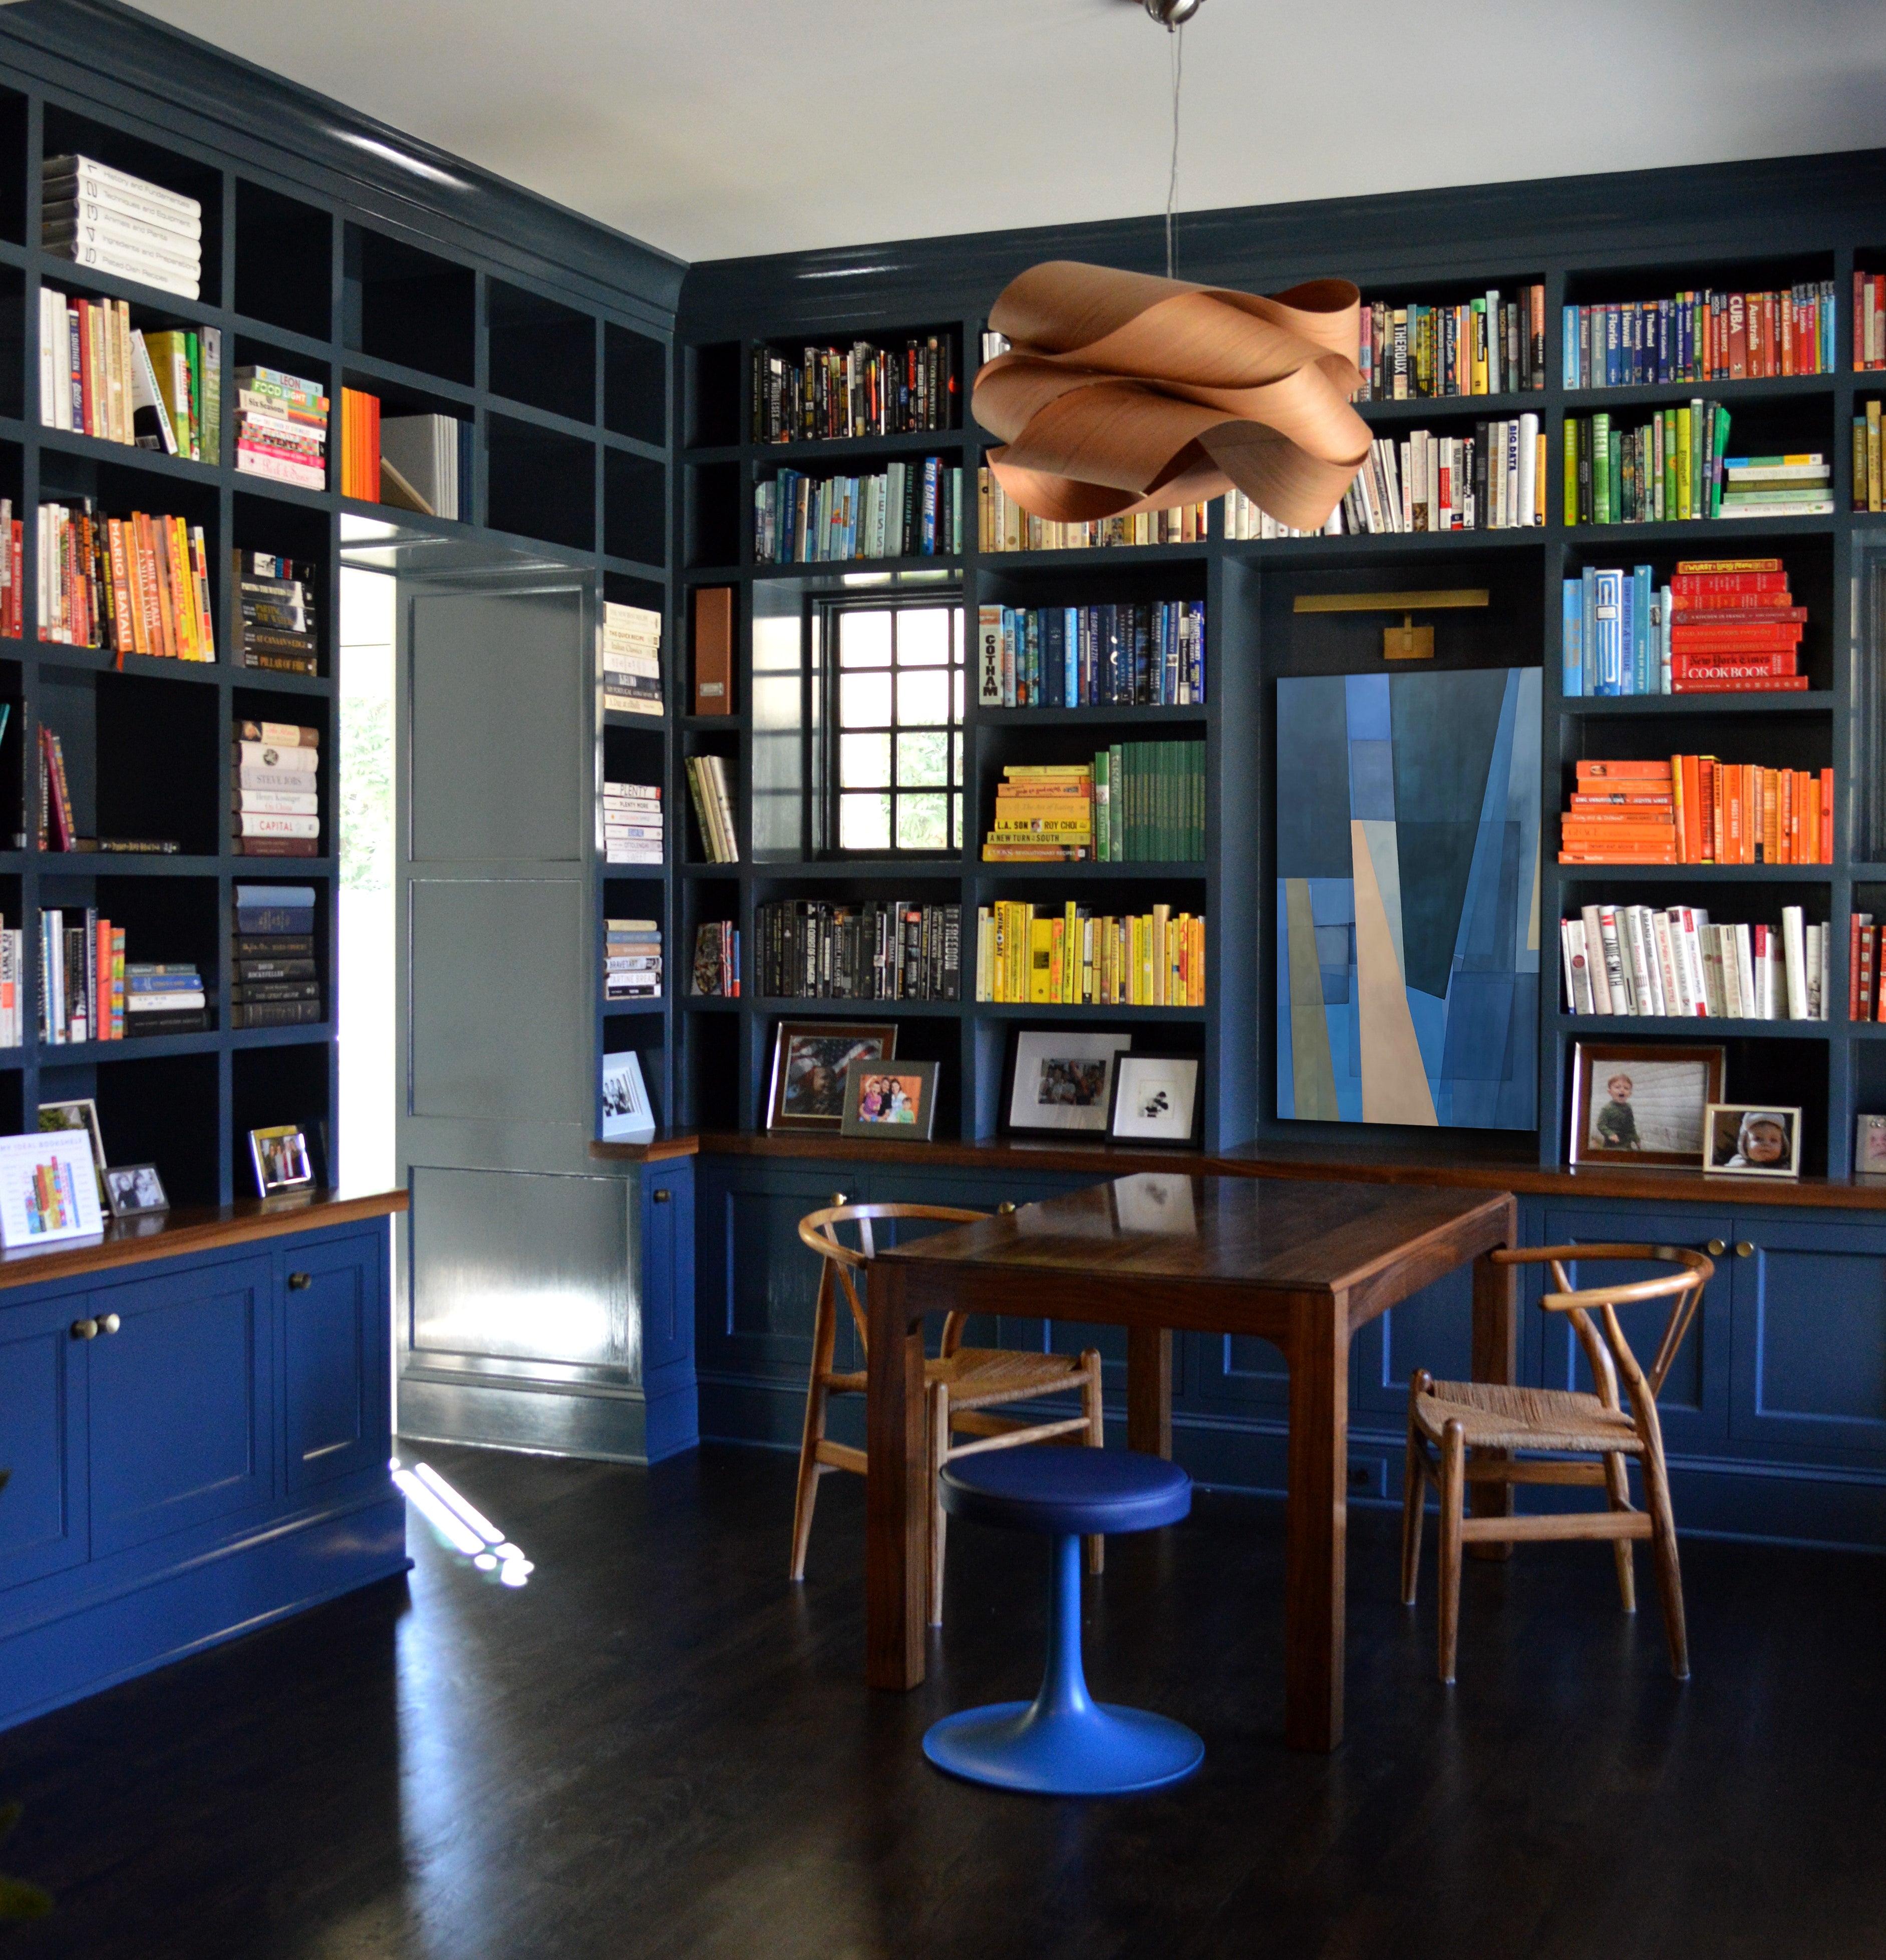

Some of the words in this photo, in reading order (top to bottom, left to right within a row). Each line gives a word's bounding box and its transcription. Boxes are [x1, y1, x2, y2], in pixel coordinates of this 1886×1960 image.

[88, 164, 97, 173] 1
[104, 172, 129, 185] History
[87, 181, 97, 198] 2
[88, 204, 98, 221] 3
[157, 210, 191, 227] Equipment
[86, 226, 97, 241] 4
[86, 248, 97, 263] 5
[1730, 296, 1743, 334] CUBA
[1609, 314, 1618, 349] Florida
[1623, 313, 1632, 347] Hawaii
[1749, 304, 1759, 350] Australia
[71, 333, 79, 370] SOUTHERN
[1394, 326, 1407, 374] THEROUX
[143, 350, 160, 401] SOUTHERN
[158, 403, 168, 427] FOOD
[280, 375, 300, 389] LEON
[73, 383, 81, 408] Belly
[254, 382, 281, 396] FOOD
[283, 389, 305, 402] LIGHT
[771, 382, 780, 417] MIDDLESEX
[259, 401, 284, 413] Seasons
[263, 434, 299, 449] TWENTY
[925, 463, 935, 481] BIG
[1679, 450, 1688, 487] groundswell
[926, 484, 934, 516] GAME
[112, 523, 124, 576] MARIO
[118, 591, 131, 643] BATALI
[1007, 630, 1013, 638] ON
[260, 655, 282, 668] PILLAR
[292, 659, 305, 670] FIRE
[983, 635, 998, 696] GOTHAM
[1691, 655, 1710, 665] New
[1713, 655, 1736, 666] York
[1740, 655, 1770, 665] Times
[1638, 681, 1644, 689] ad
[284, 776, 301, 784] JOBS
[620, 784, 648, 797] PLENTY
[259, 821, 292, 831] CAPITAL
[807, 919, 816, 928] THE
[1643, 913, 1651, 939] BRAND
[945, 923, 958, 970] FREEDOM
[1604, 938, 1618, 959] ZADIE
[1630, 915, 1638, 943] Promises
[1634, 945, 1643, 973] Betrayed
[1605, 961, 1623, 987] SMITH
[39, 1138, 82, 1147] BOOKSHELF
